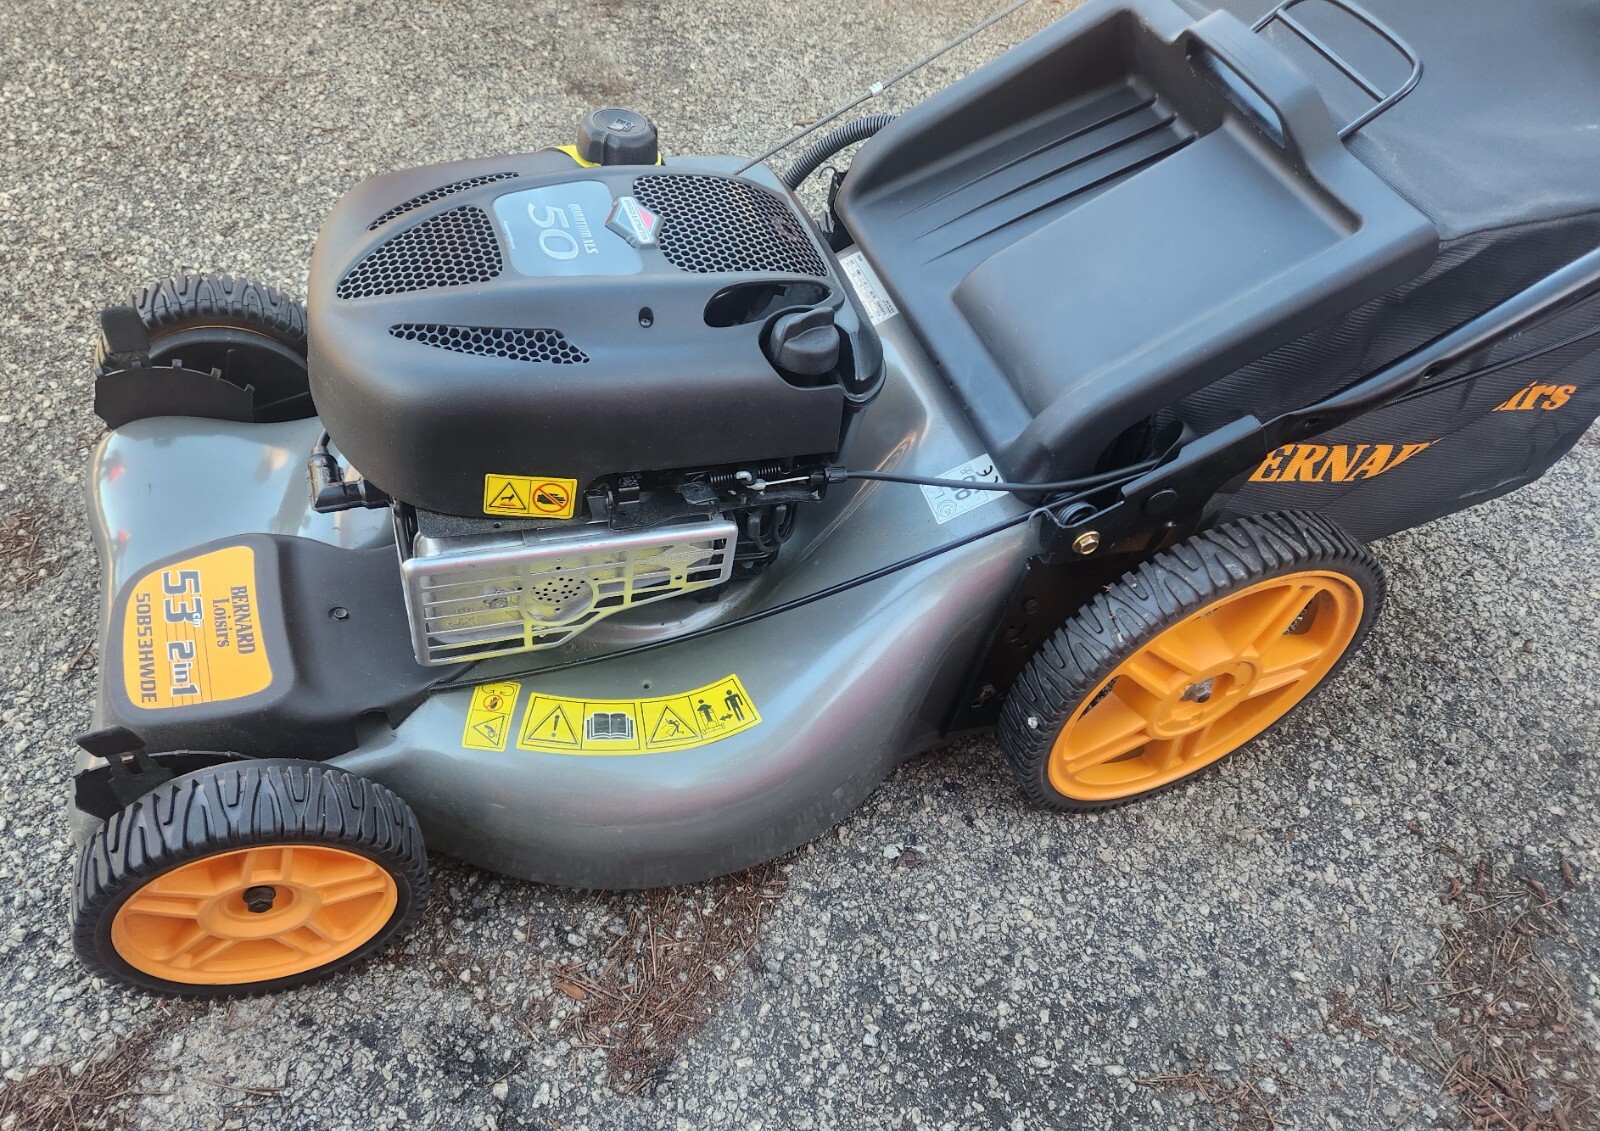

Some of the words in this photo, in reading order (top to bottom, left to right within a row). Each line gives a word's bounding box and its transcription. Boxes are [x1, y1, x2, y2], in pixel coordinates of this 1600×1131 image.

[527, 202, 579, 261] 50
[568, 203, 592, 238] QUANTUM
[582, 239, 599, 254] XLS
[1490, 380, 1578, 412] irs
[161, 569, 204, 624] 53
[192, 612, 203, 628] cm
[212, 597, 232, 648] Loisirs
[230, 585, 256, 655] BERNARD
[136, 593, 158, 703] 50B53HWDE
[167, 640, 200, 698] 2in1
